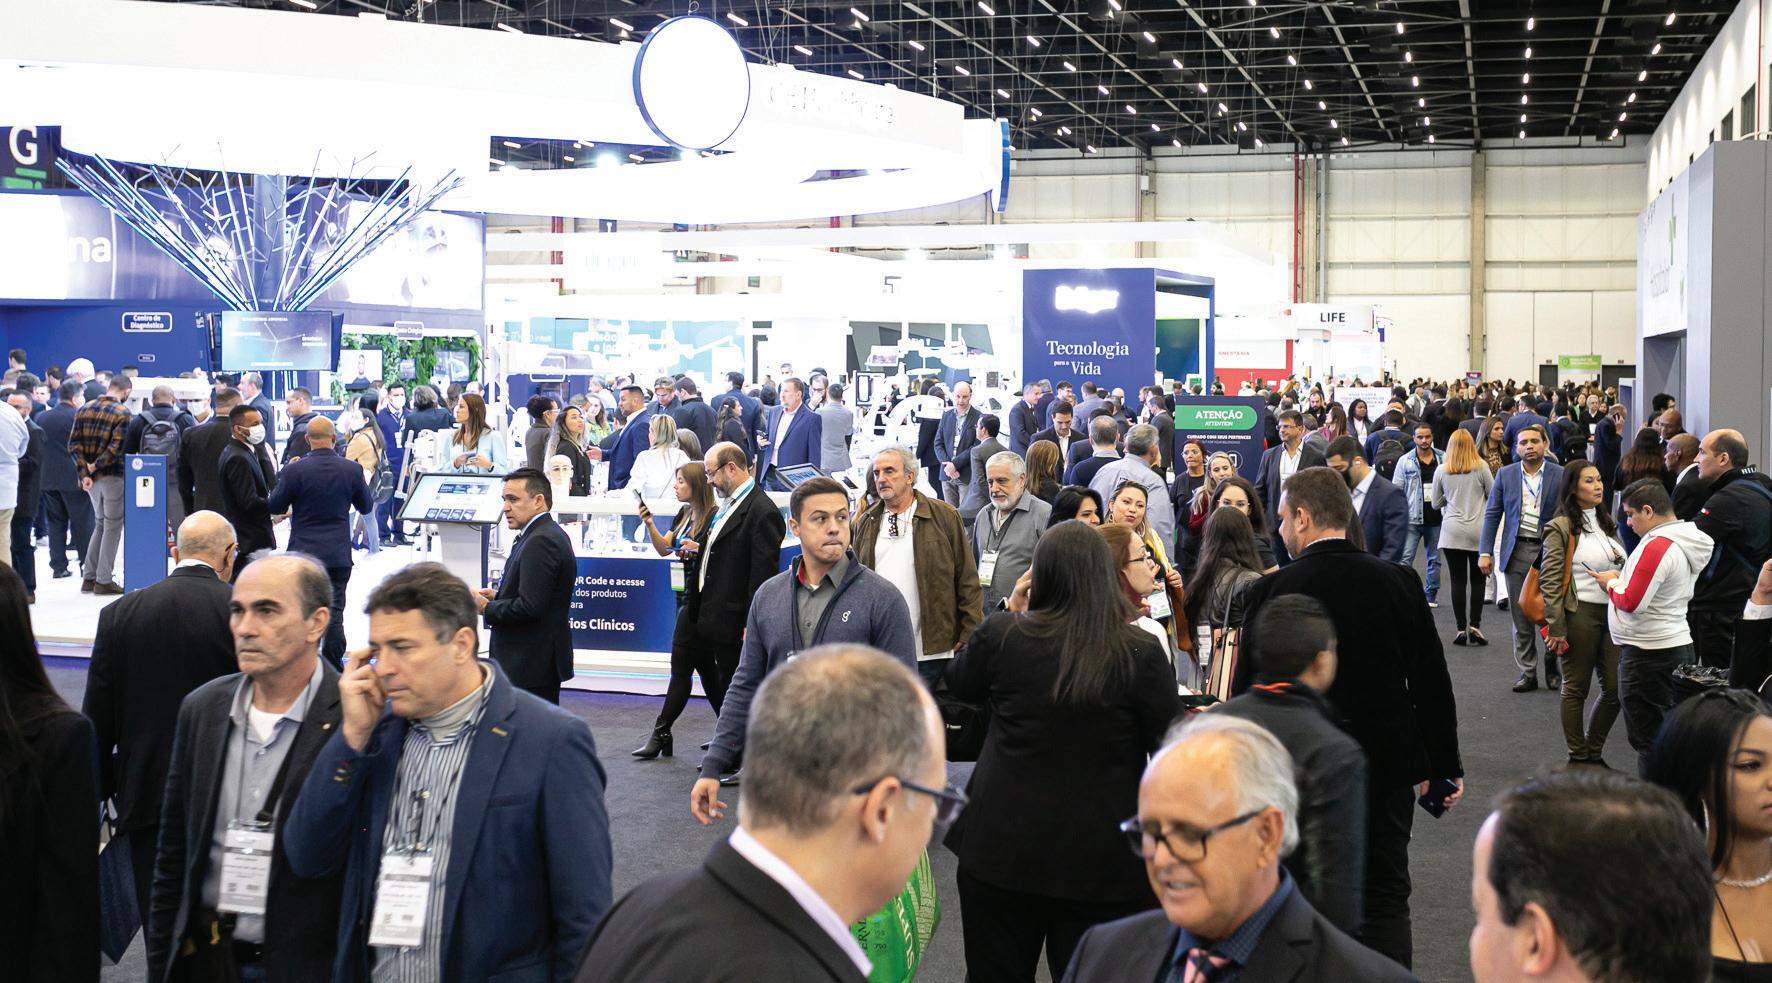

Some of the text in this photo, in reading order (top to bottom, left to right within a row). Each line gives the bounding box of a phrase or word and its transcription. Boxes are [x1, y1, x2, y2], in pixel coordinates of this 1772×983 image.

[1320, 312, 1346, 323] LIFE
[130, 322, 164, 330] Diagnóstico
[1046, 340, 1130, 360] Tecnologia
[1071, 361, 1102, 375] Vida
[1195, 409, 1244, 420] ATENÇÃO
[585, 576, 608, 586] Code
[616, 579, 646, 587] acesse
[575, 588, 628, 599] dos produtos
[589, 618, 636, 632] Clínicos
